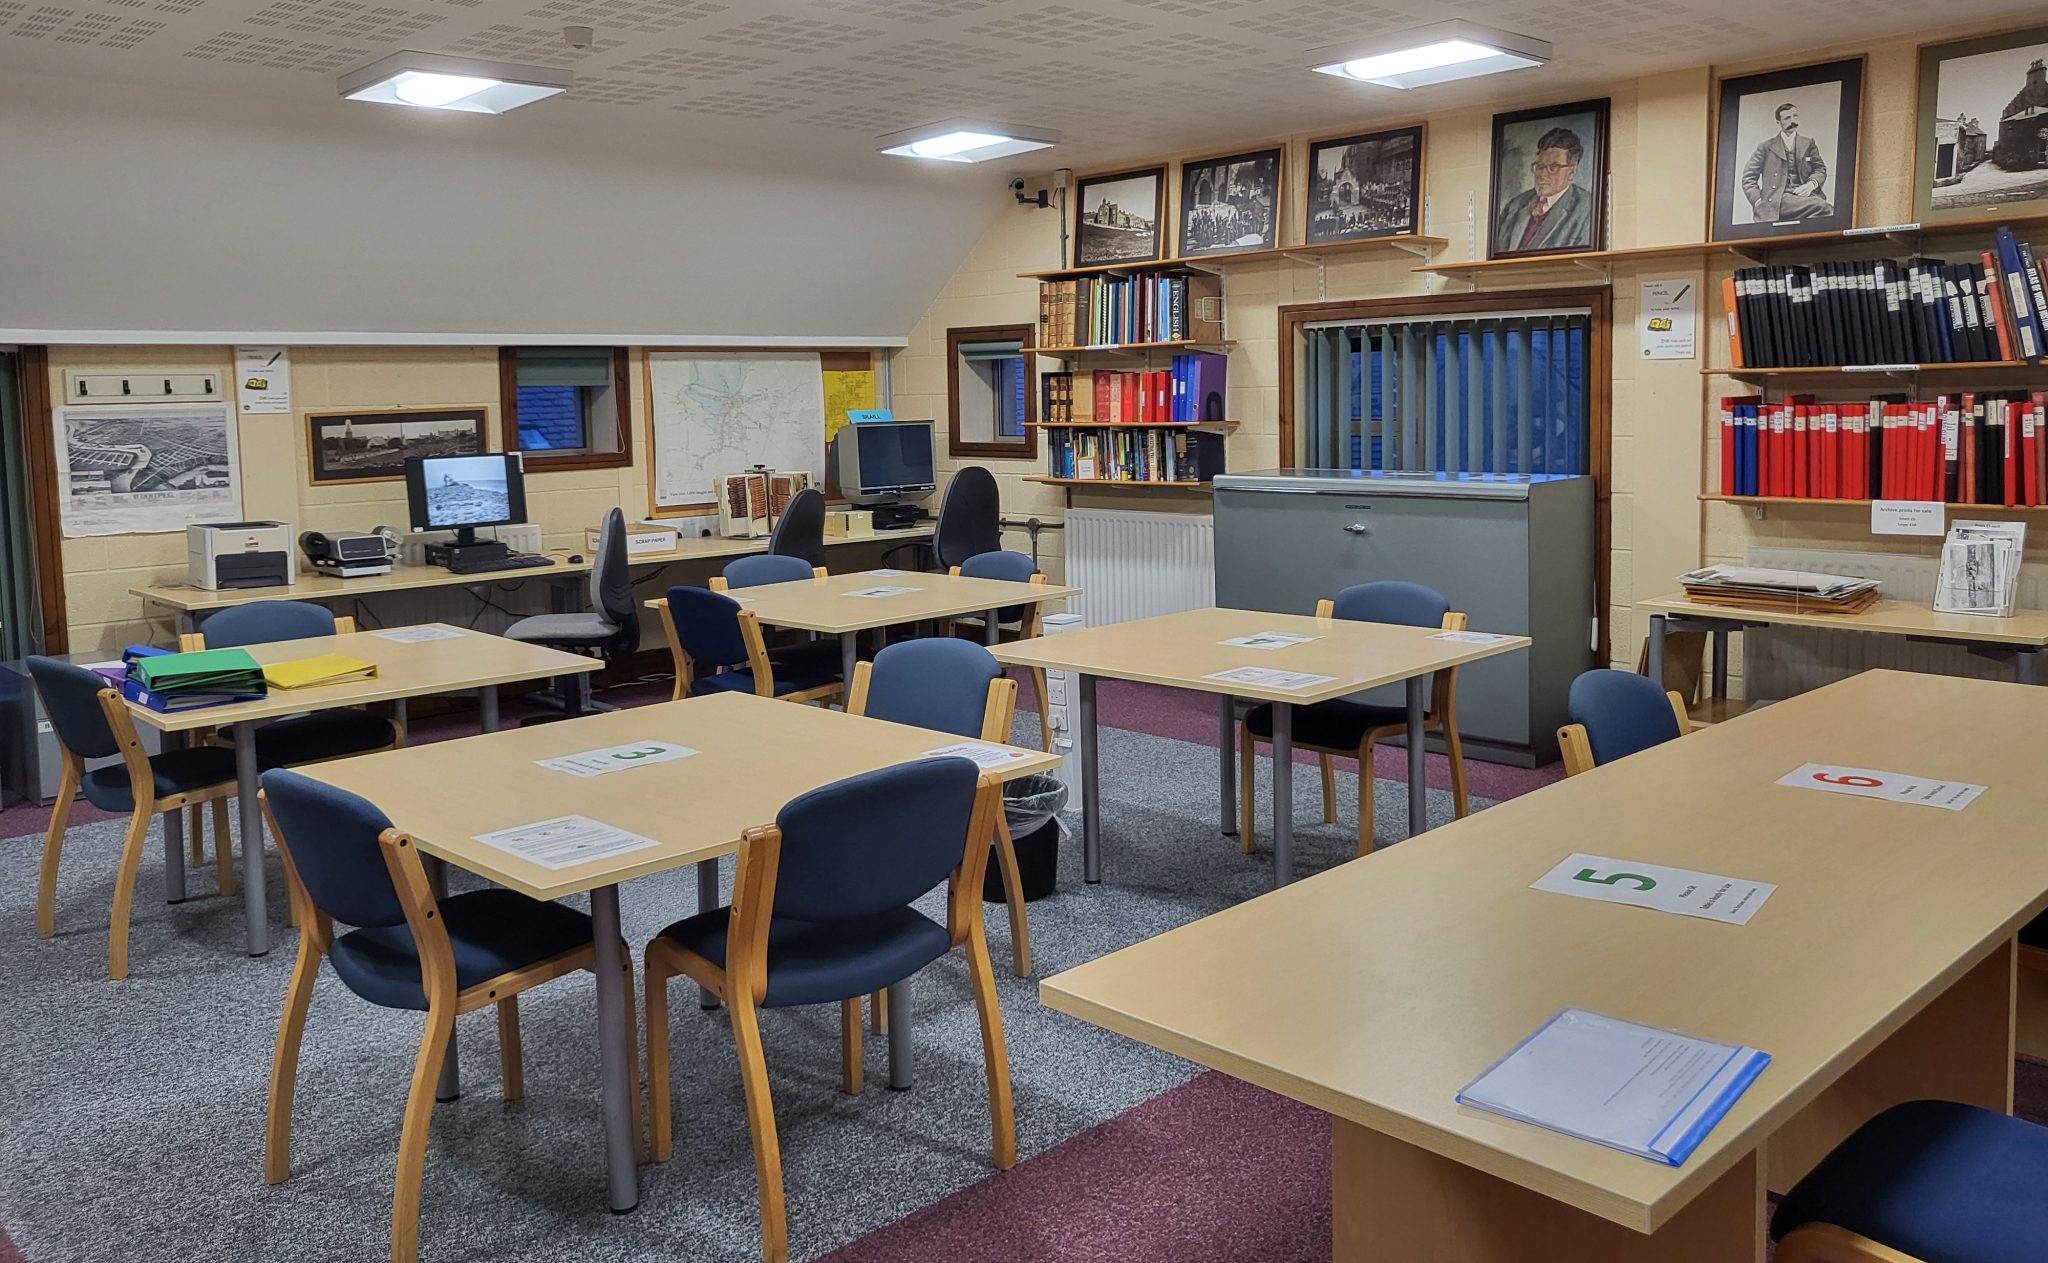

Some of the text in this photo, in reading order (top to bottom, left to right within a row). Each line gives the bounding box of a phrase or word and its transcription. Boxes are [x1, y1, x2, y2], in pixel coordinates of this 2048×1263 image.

[2027, 267, 2040, 285] ATLAS
[2033, 291, 2047, 310] WORLD
[611, 746, 667, 760] 3
[1812, 772, 1883, 787] 6
[1572, 868, 1657, 891] 5
